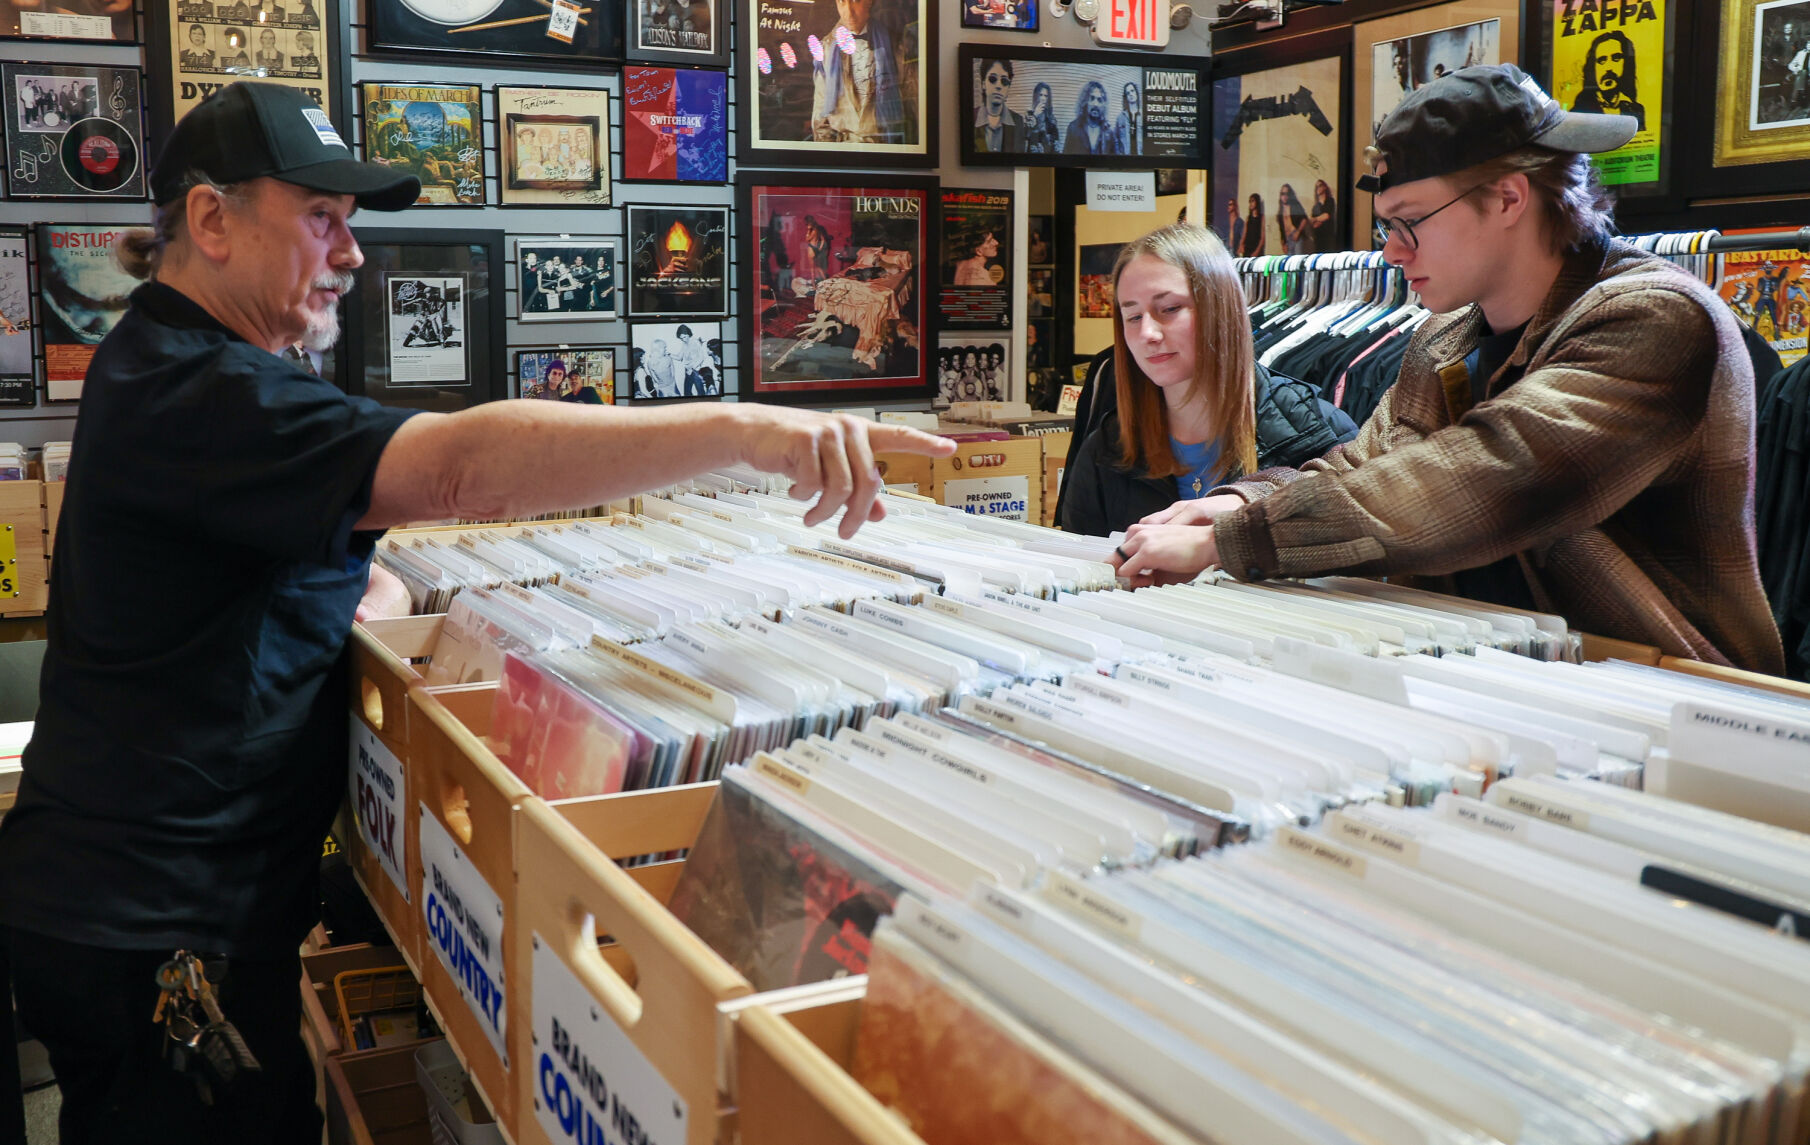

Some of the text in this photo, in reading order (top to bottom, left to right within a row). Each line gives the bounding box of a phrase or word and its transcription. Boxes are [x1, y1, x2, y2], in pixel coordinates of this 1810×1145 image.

[761, 3, 792, 15] Famous
[1561, 1, 1657, 37] ZAPPA
[760, 17, 801, 32] At Night
[1111, 0, 1157, 41] EXIT
[1146, 71, 1197, 91] LOUDMOUTH
[425, 89, 471, 102] MARCH
[1147, 104, 1197, 113] DEBUT ALBUM
[650, 114, 702, 128] SWITCHBACK
[856, 197, 919, 213] HOUNDS
[1018, 422, 1070, 437] Tommy
[966, 492, 1012, 502] PRE-OWNED
[989, 500, 1025, 513] STAGE
[802, 616, 849, 637] JOHNNY CASH
[860, 606, 904, 627] LUKE COMBS
[622, 653, 648, 670] ARTISTS
[974, 704, 991, 715] DOLLY
[1694, 711, 1767, 734] MIDDLE
[882, 731, 988, 784] MIDNIGHT COWGIRLS
[358, 743, 396, 801] PRE-OWNED
[356, 771, 399, 875] FOLK
[431, 863, 490, 961] BRAND NEW
[426, 892, 502, 1034] COUNTRY
[551, 1016, 608, 1112] BRAND
